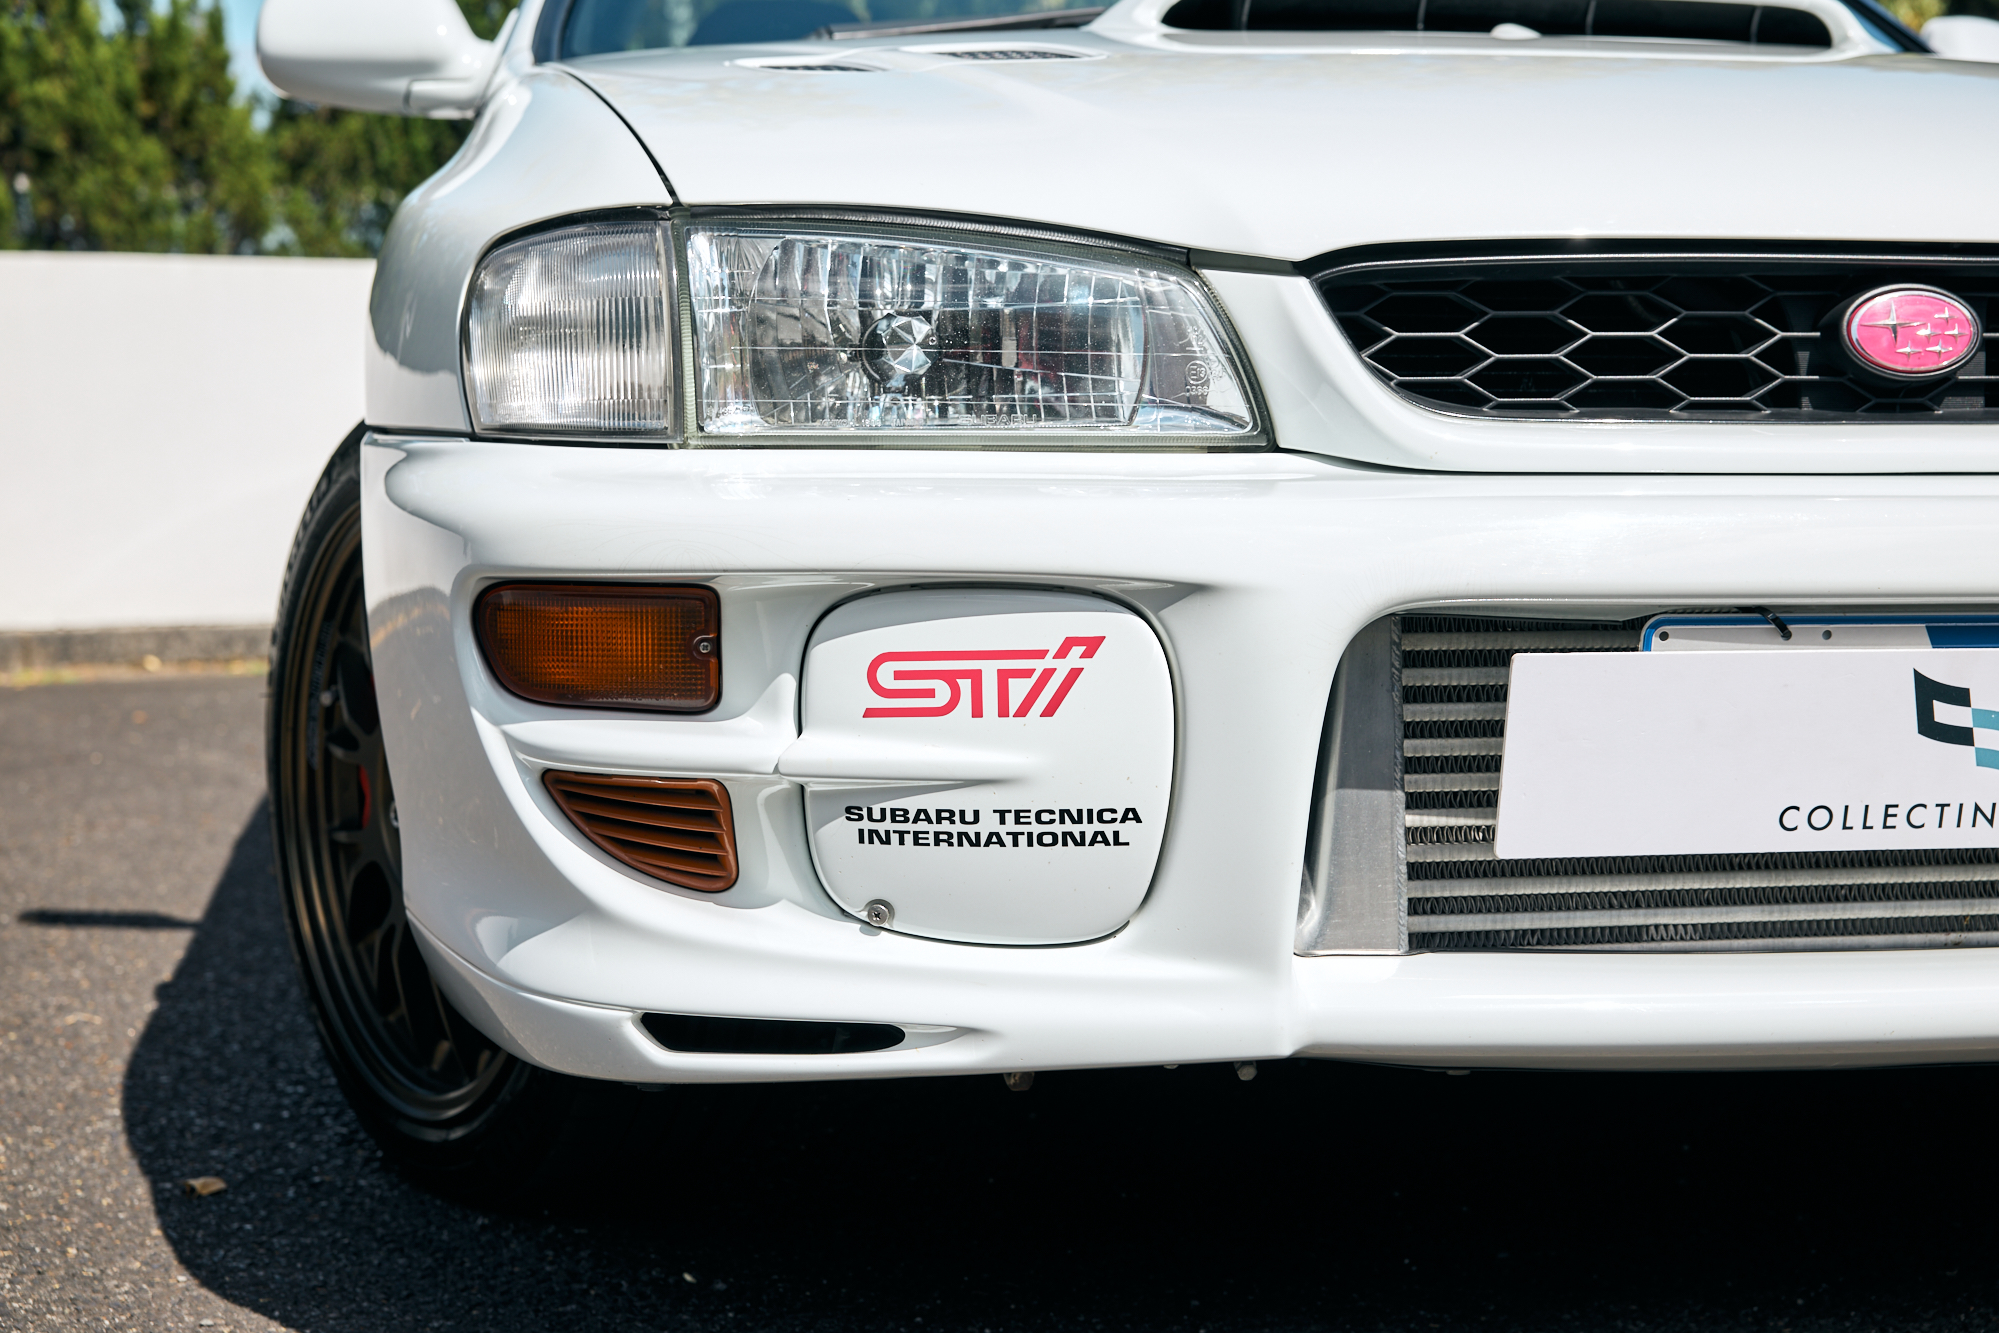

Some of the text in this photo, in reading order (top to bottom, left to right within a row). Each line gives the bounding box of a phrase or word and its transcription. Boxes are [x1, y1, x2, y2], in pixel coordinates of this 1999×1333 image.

[844, 805, 1143, 826] SUBARU TECNICA
[1778, 801, 1997, 832] COLLECTIN
[857, 828, 1130, 848] INTERNATIONAL
